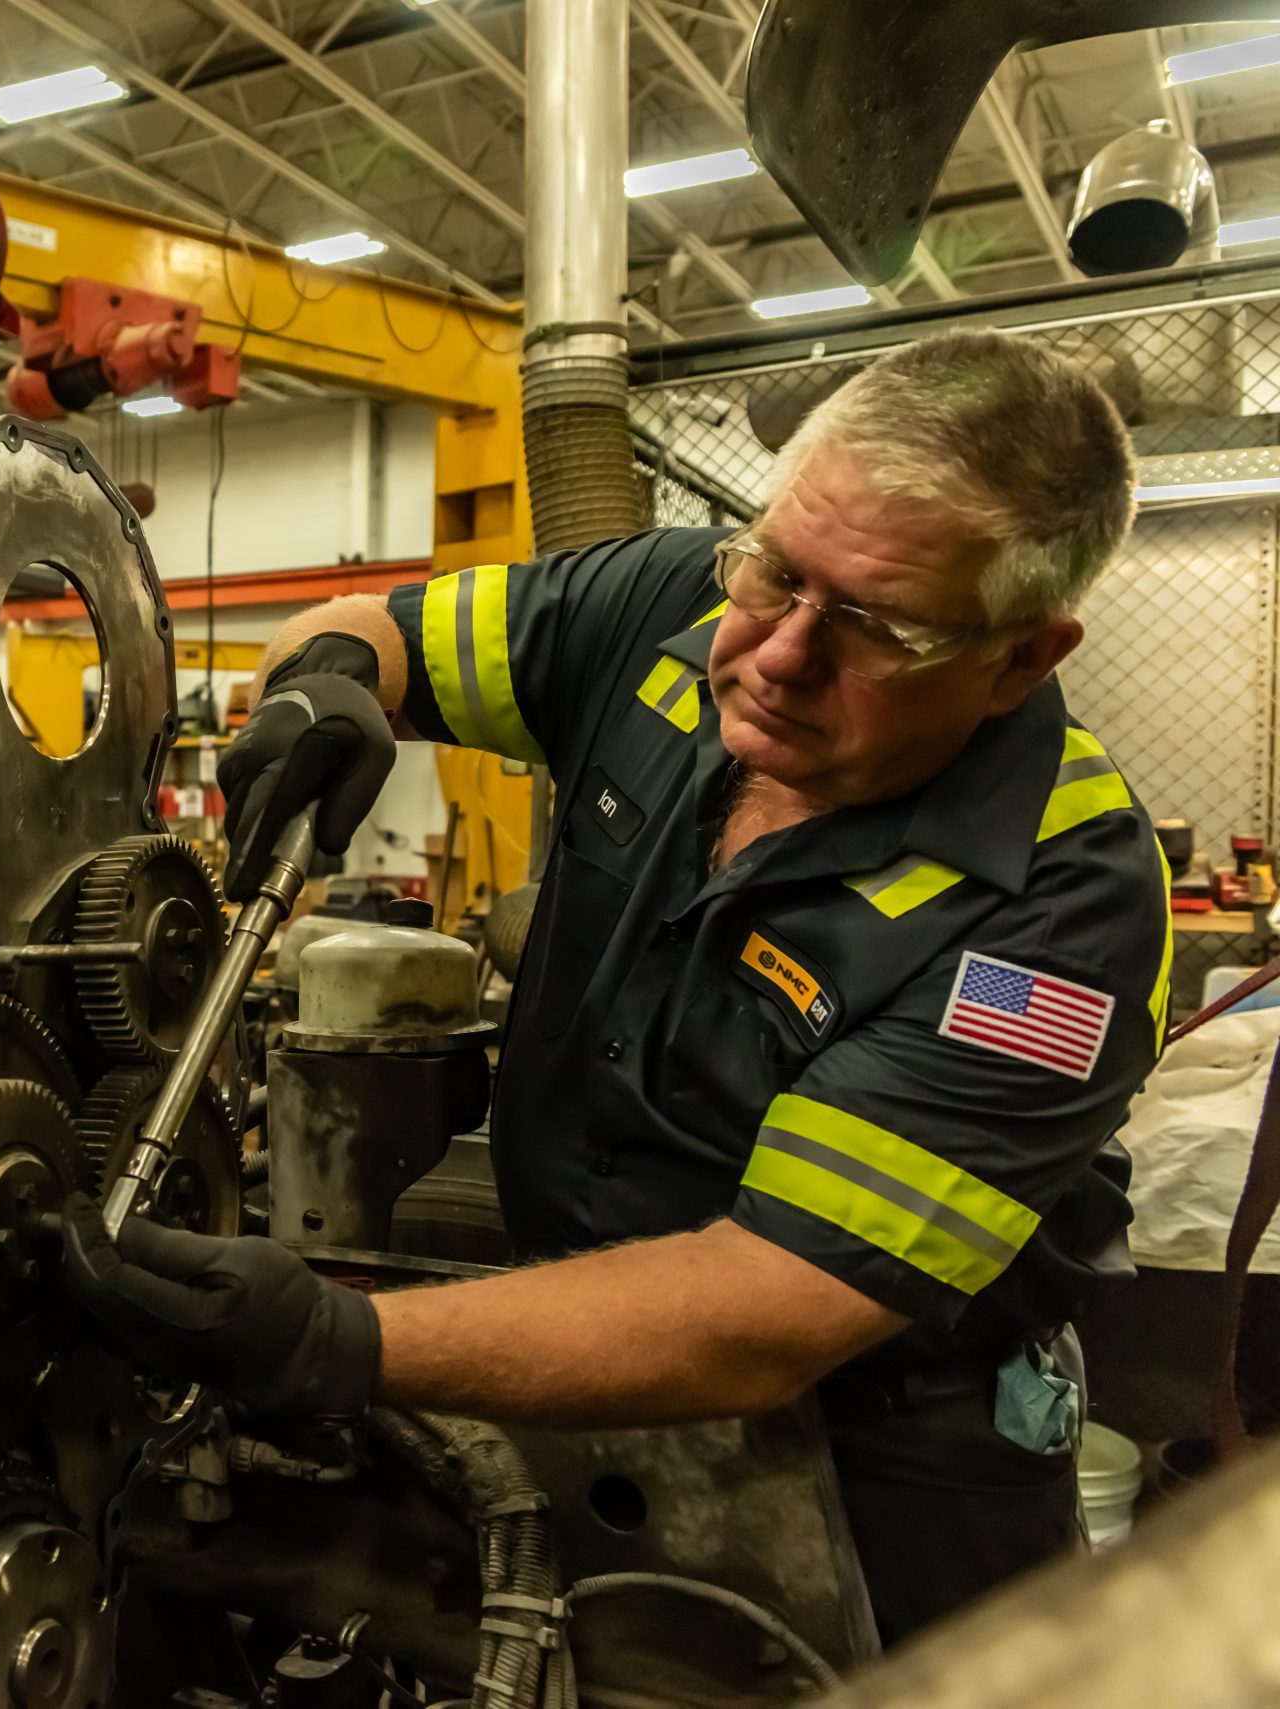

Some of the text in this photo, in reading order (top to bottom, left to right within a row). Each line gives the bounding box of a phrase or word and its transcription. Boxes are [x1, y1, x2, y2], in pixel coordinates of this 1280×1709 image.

[597, 788, 617, 818] Ian
[776, 962, 810, 995] NMC
[811, 998, 828, 1023] CAT
